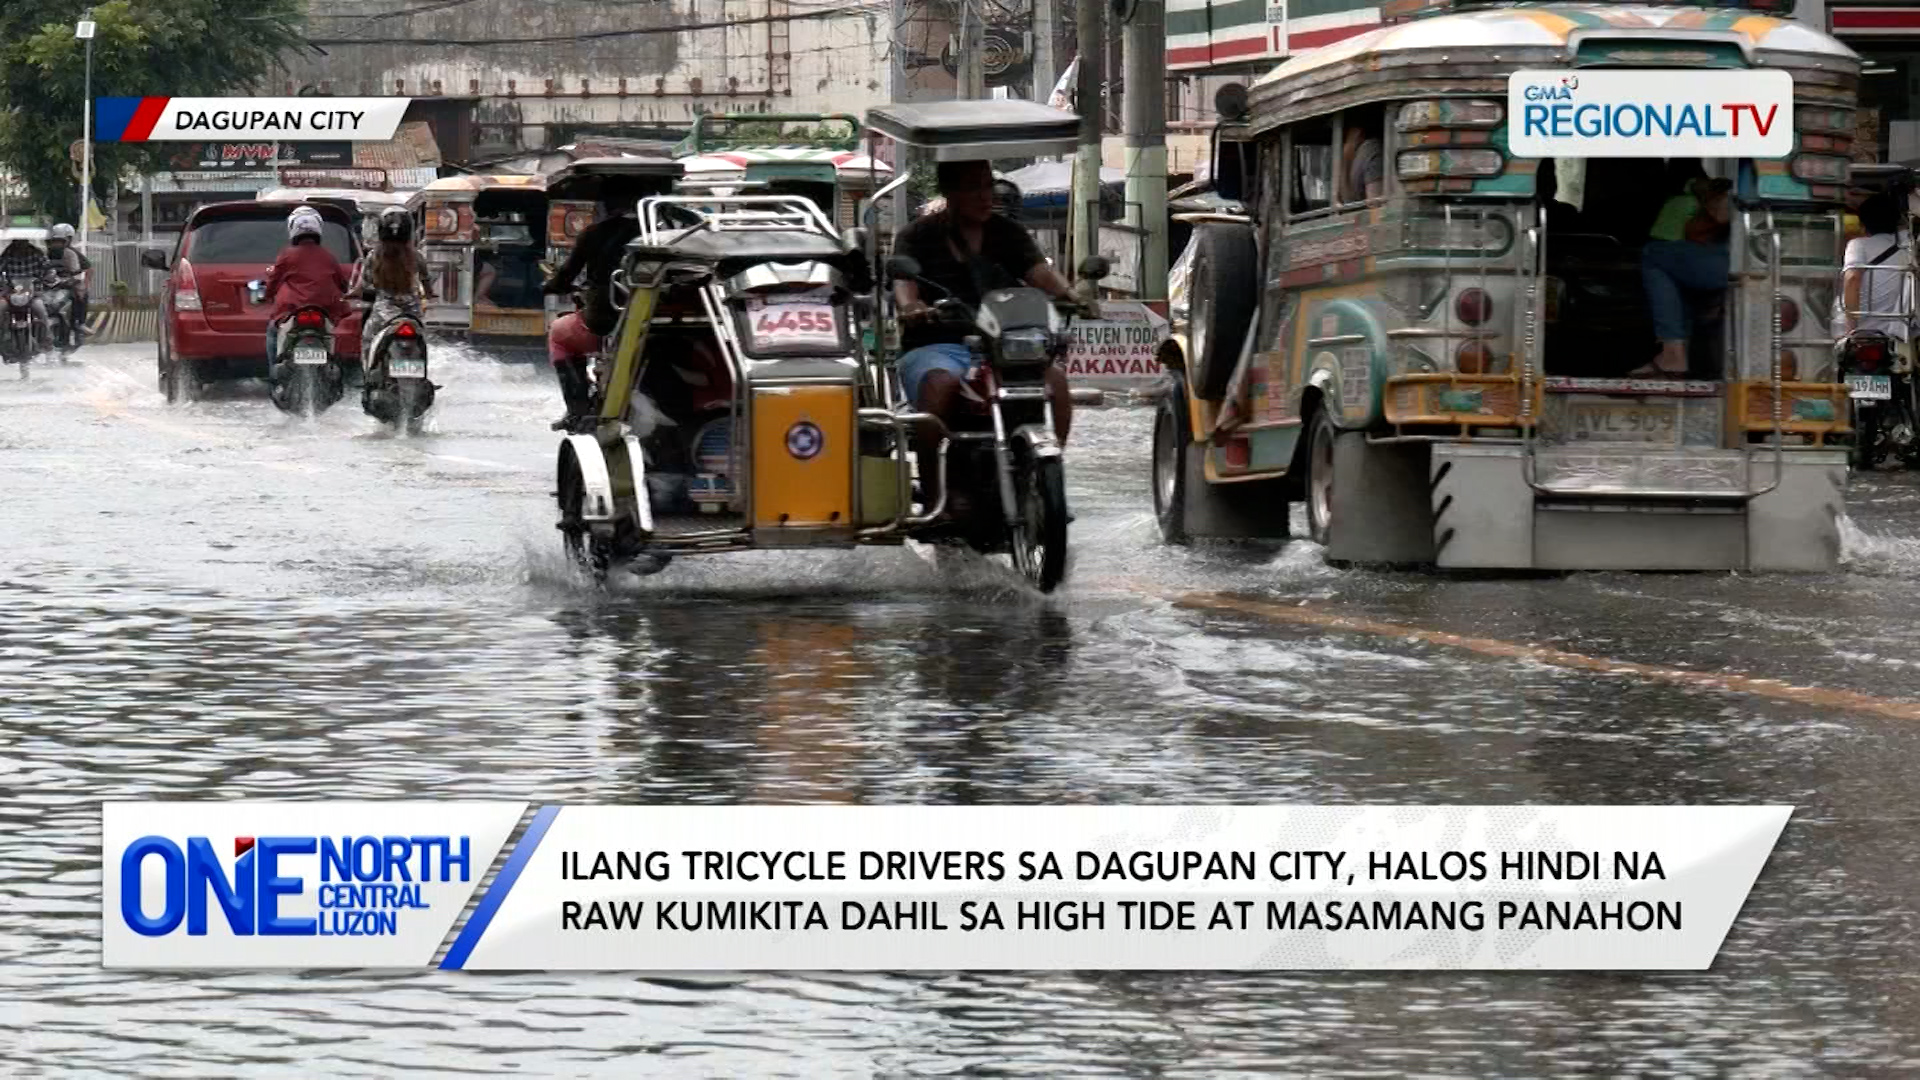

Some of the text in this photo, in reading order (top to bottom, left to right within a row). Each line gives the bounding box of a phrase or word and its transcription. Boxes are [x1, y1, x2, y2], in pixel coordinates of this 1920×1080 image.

[757, 311, 832, 333] 4455
[1126, 327, 1158, 344] TODA
[1090, 345, 1126, 355] LANG
[1060, 359, 1161, 374] AKAYAN
